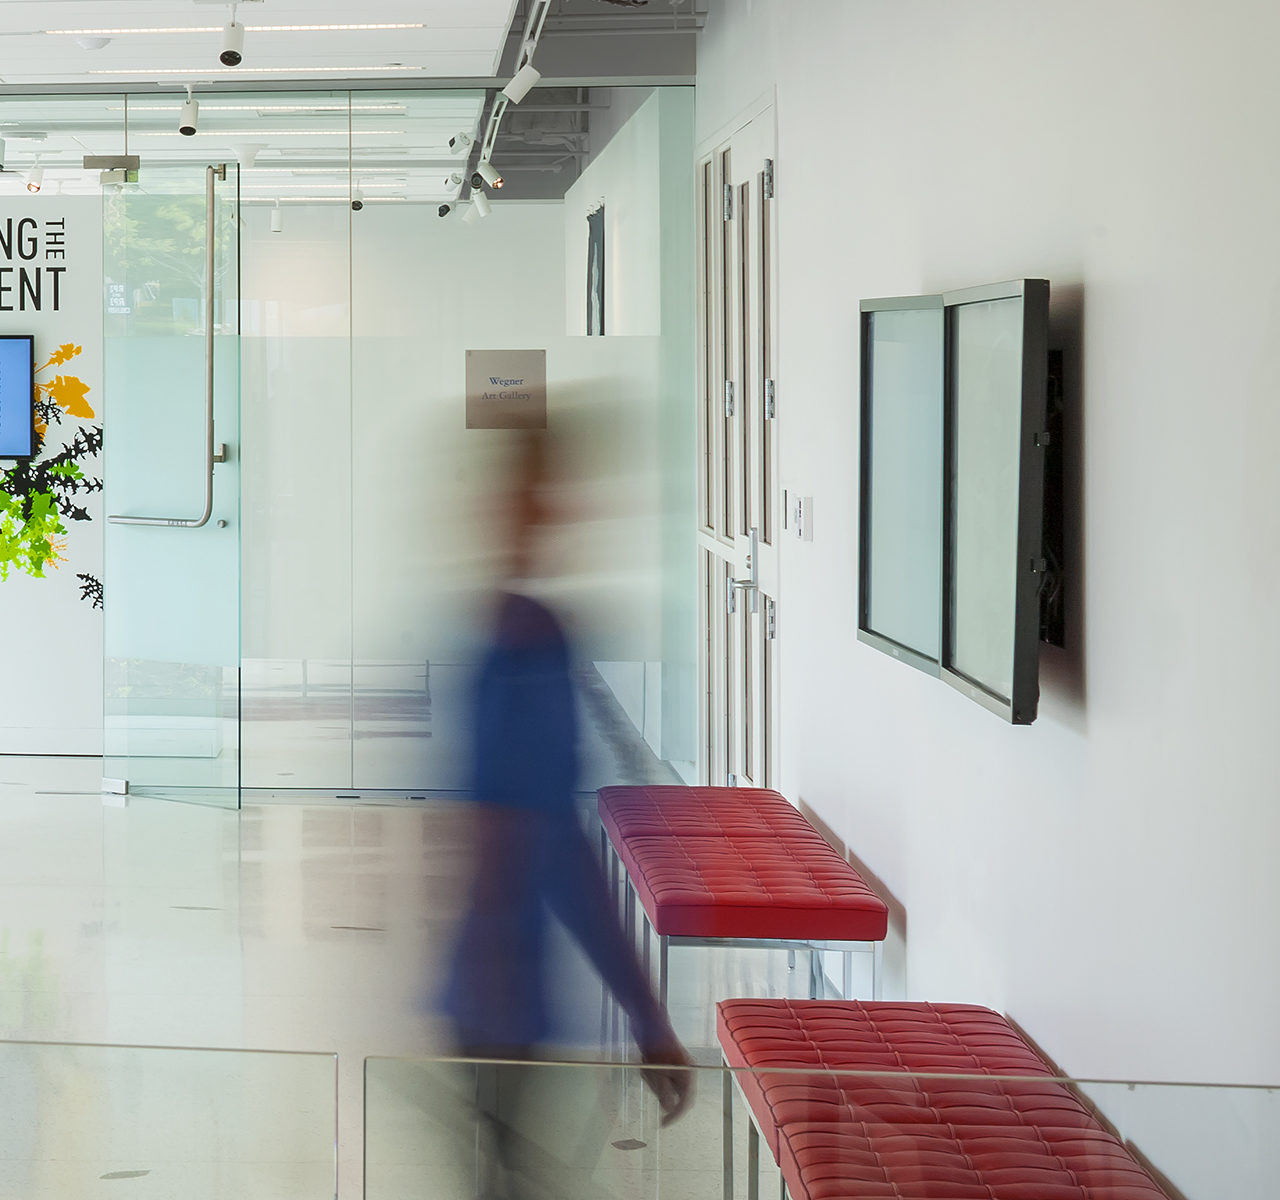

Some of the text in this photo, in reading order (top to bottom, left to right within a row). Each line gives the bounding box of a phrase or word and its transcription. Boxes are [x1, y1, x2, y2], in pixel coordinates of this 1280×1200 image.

[45, 217, 65, 259] THE
[489, 377, 524, 387] Wegner
[481, 392, 531, 401] Art Gallery
